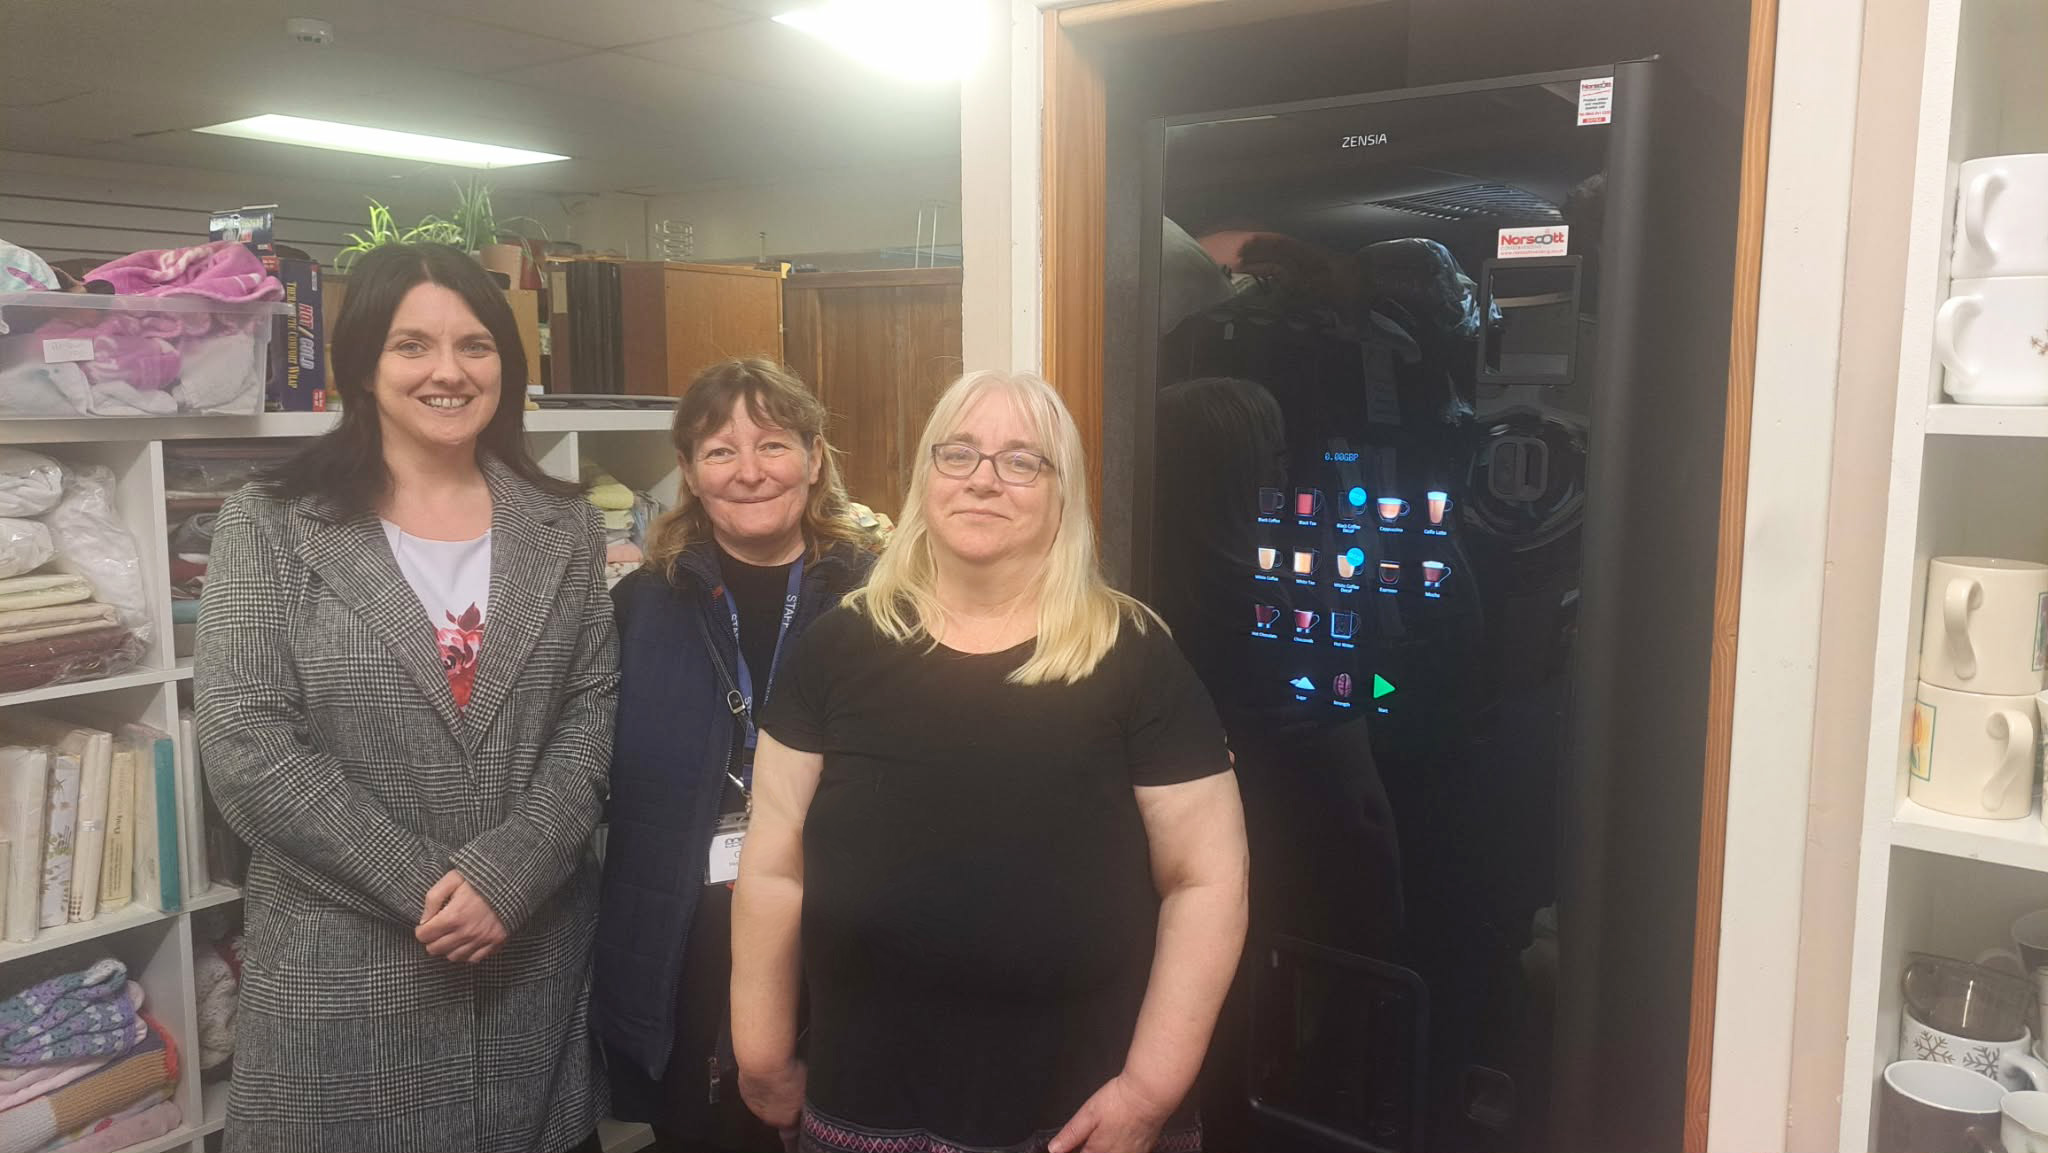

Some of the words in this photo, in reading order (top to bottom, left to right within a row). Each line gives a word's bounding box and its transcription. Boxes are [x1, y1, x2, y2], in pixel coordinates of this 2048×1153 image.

[1342, 133, 1387, 148] ZENSIA
[1501, 231, 1565, 245] Norscott
[288, 332, 298, 364] COMFORT
[288, 366, 299, 389] WRAP
[1324, 452, 1359, 461] 0.00GBP
